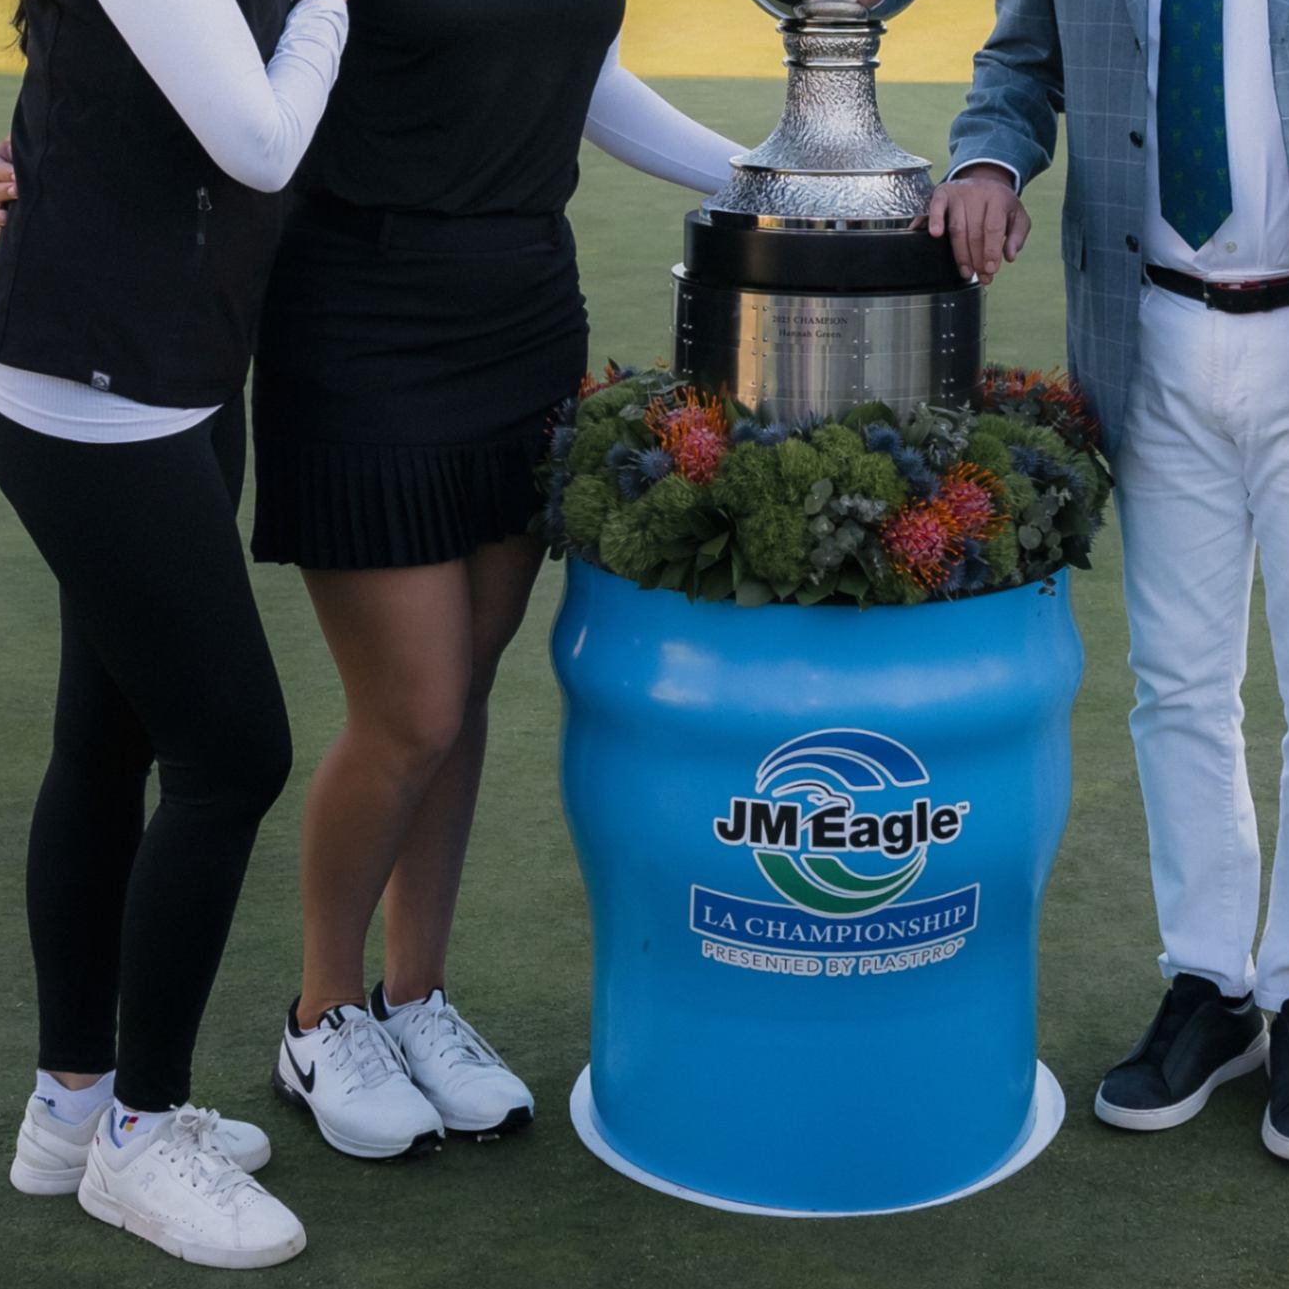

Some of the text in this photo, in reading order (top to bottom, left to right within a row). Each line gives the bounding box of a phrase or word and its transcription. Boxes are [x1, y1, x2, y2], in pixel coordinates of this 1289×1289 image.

[793, 316, 848, 325] CHAMPION
[715, 799, 800, 848] JM
[703, 904, 967, 944] LA CHAMPIONSHIP
[704, 942, 820, 974] PRESENTED
[828, 959, 853, 973] BY
